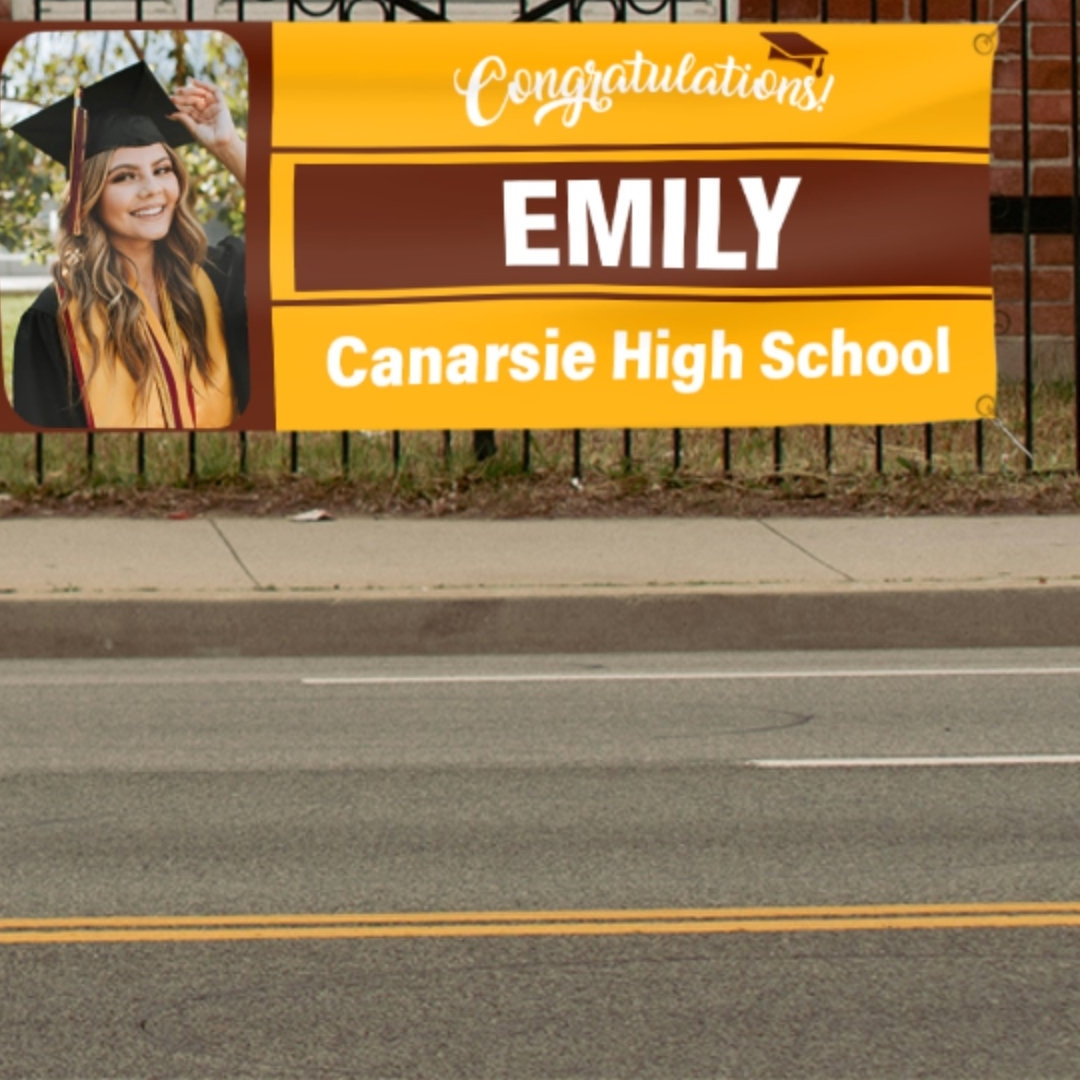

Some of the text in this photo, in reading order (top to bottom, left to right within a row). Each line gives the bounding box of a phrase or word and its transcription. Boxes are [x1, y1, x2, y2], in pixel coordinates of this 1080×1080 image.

[454, 51, 834, 128] Congratulations!
[503, 177, 801, 270] EMILY
[327, 326, 949, 394] Canarsie High School
